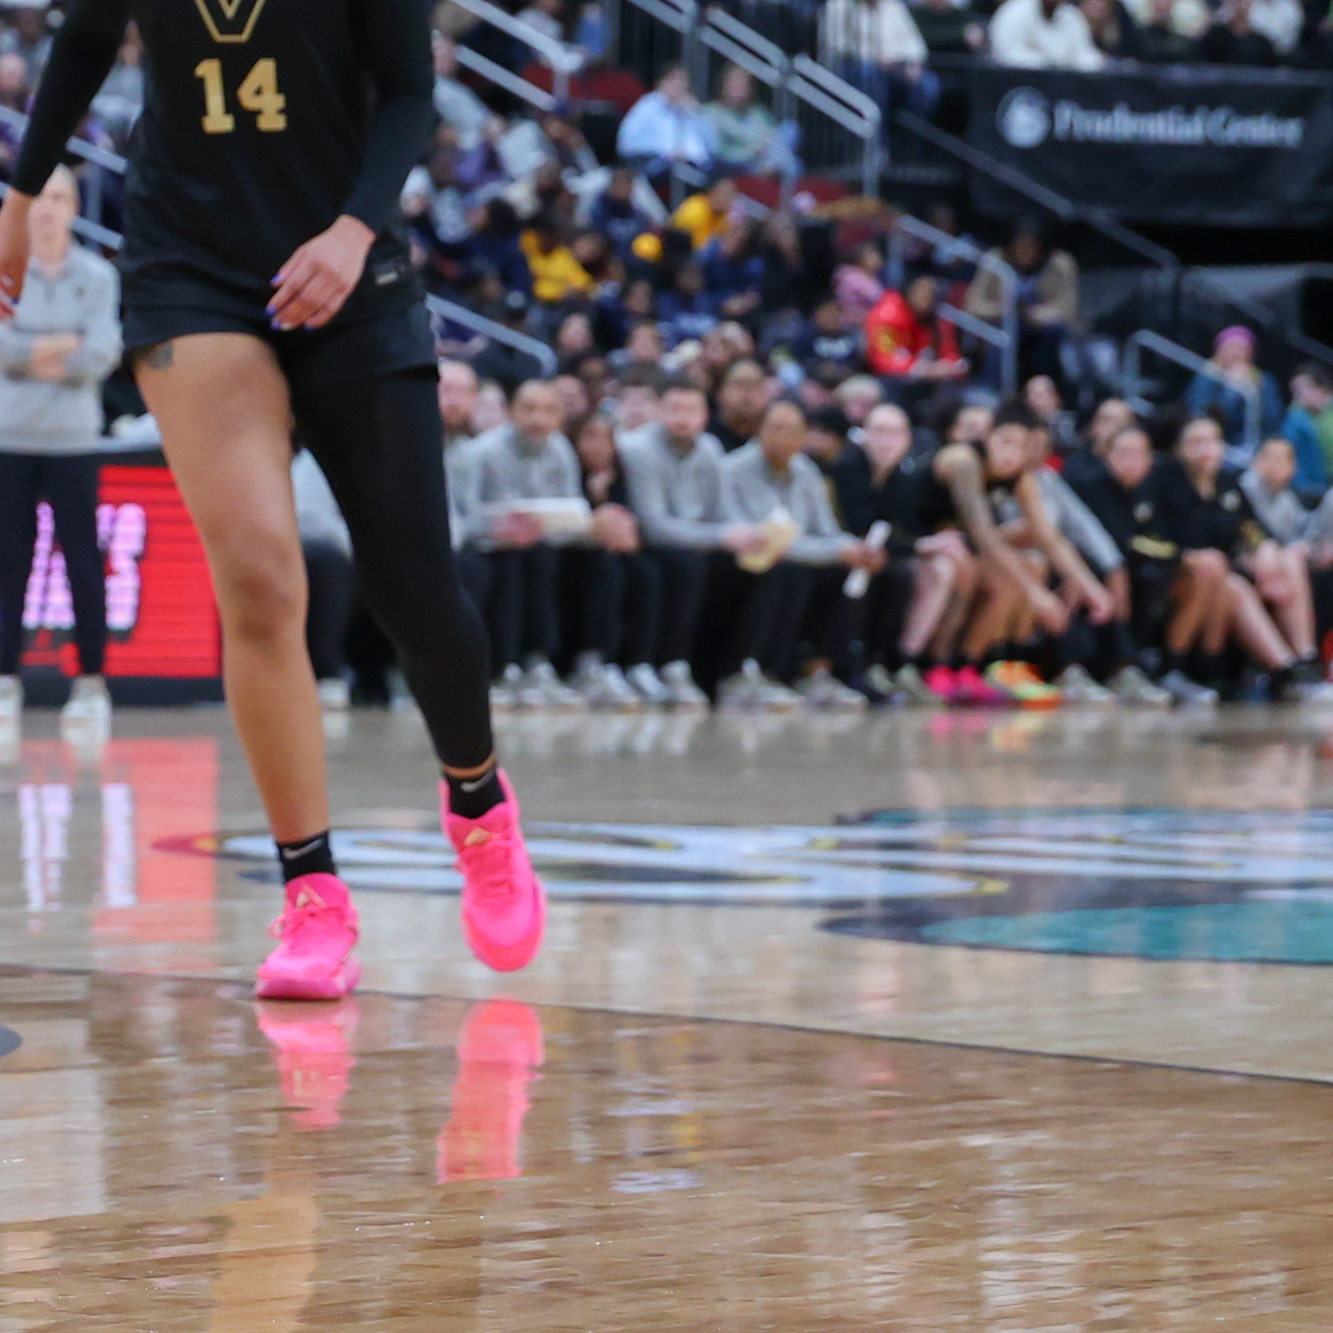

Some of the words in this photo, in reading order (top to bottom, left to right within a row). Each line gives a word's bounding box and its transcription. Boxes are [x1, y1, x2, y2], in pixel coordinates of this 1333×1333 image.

[194, 57, 288, 134] 14
[1053, 99, 1204, 145] Prudential
[1206, 105, 1304, 148] Center
